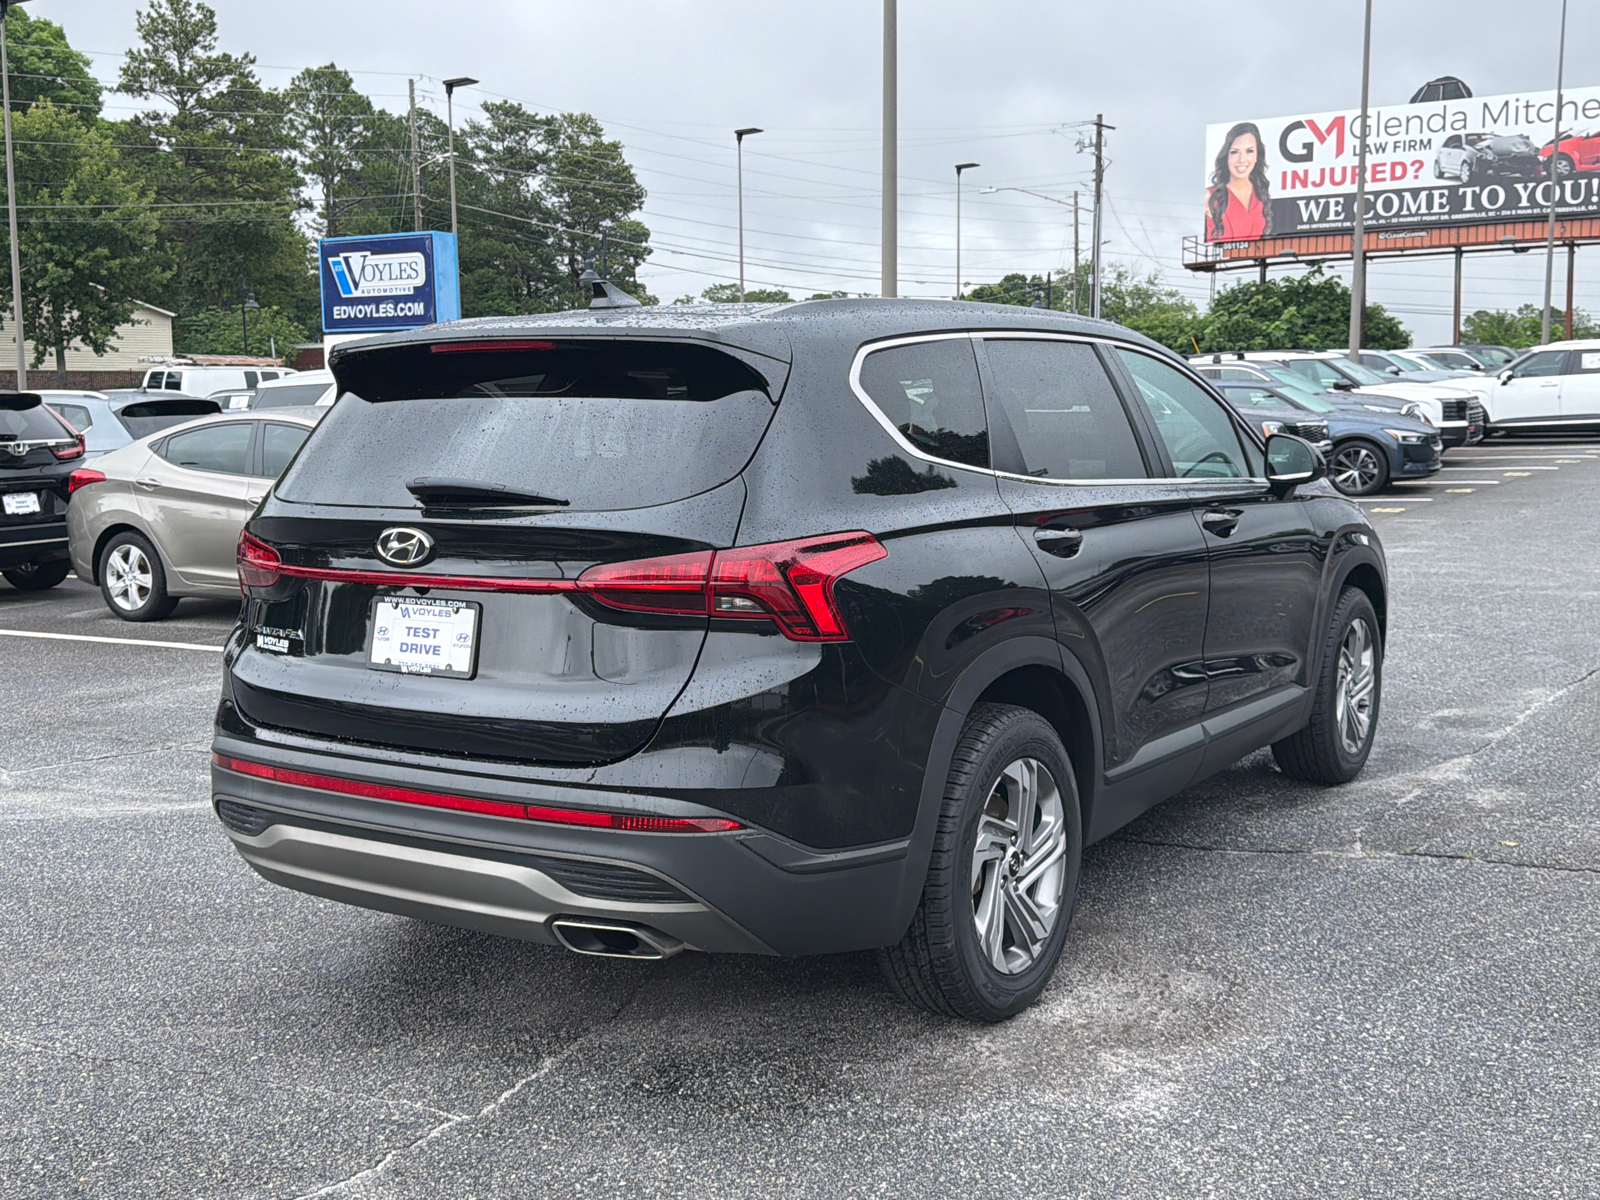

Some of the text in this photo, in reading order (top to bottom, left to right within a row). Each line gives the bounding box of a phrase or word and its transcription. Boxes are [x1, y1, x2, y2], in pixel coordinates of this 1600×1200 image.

[1349, 105, 1468, 140] Glenda
[1278, 115, 1346, 163] GM
[1352, 136, 1433, 157] LAW FIRM
[1280, 159, 1425, 191] INJURED?
[1296, 177, 1600, 223] WE COME TO YOU!
[1223, 242, 1249, 250] 051124
[342, 255, 419, 291] VOYLES
[361, 286, 412, 295] AUTOMOTIVE
[333, 302, 425, 319] EDVOYLES.COM
[384, 596, 467, 609] WWW.EDVOYLES.COM
[411, 607, 452, 618] VOYLES
[405, 626, 440, 639] TEST
[264, 635, 289, 648] VOYLES
[399, 642, 441, 656] DRIVE
